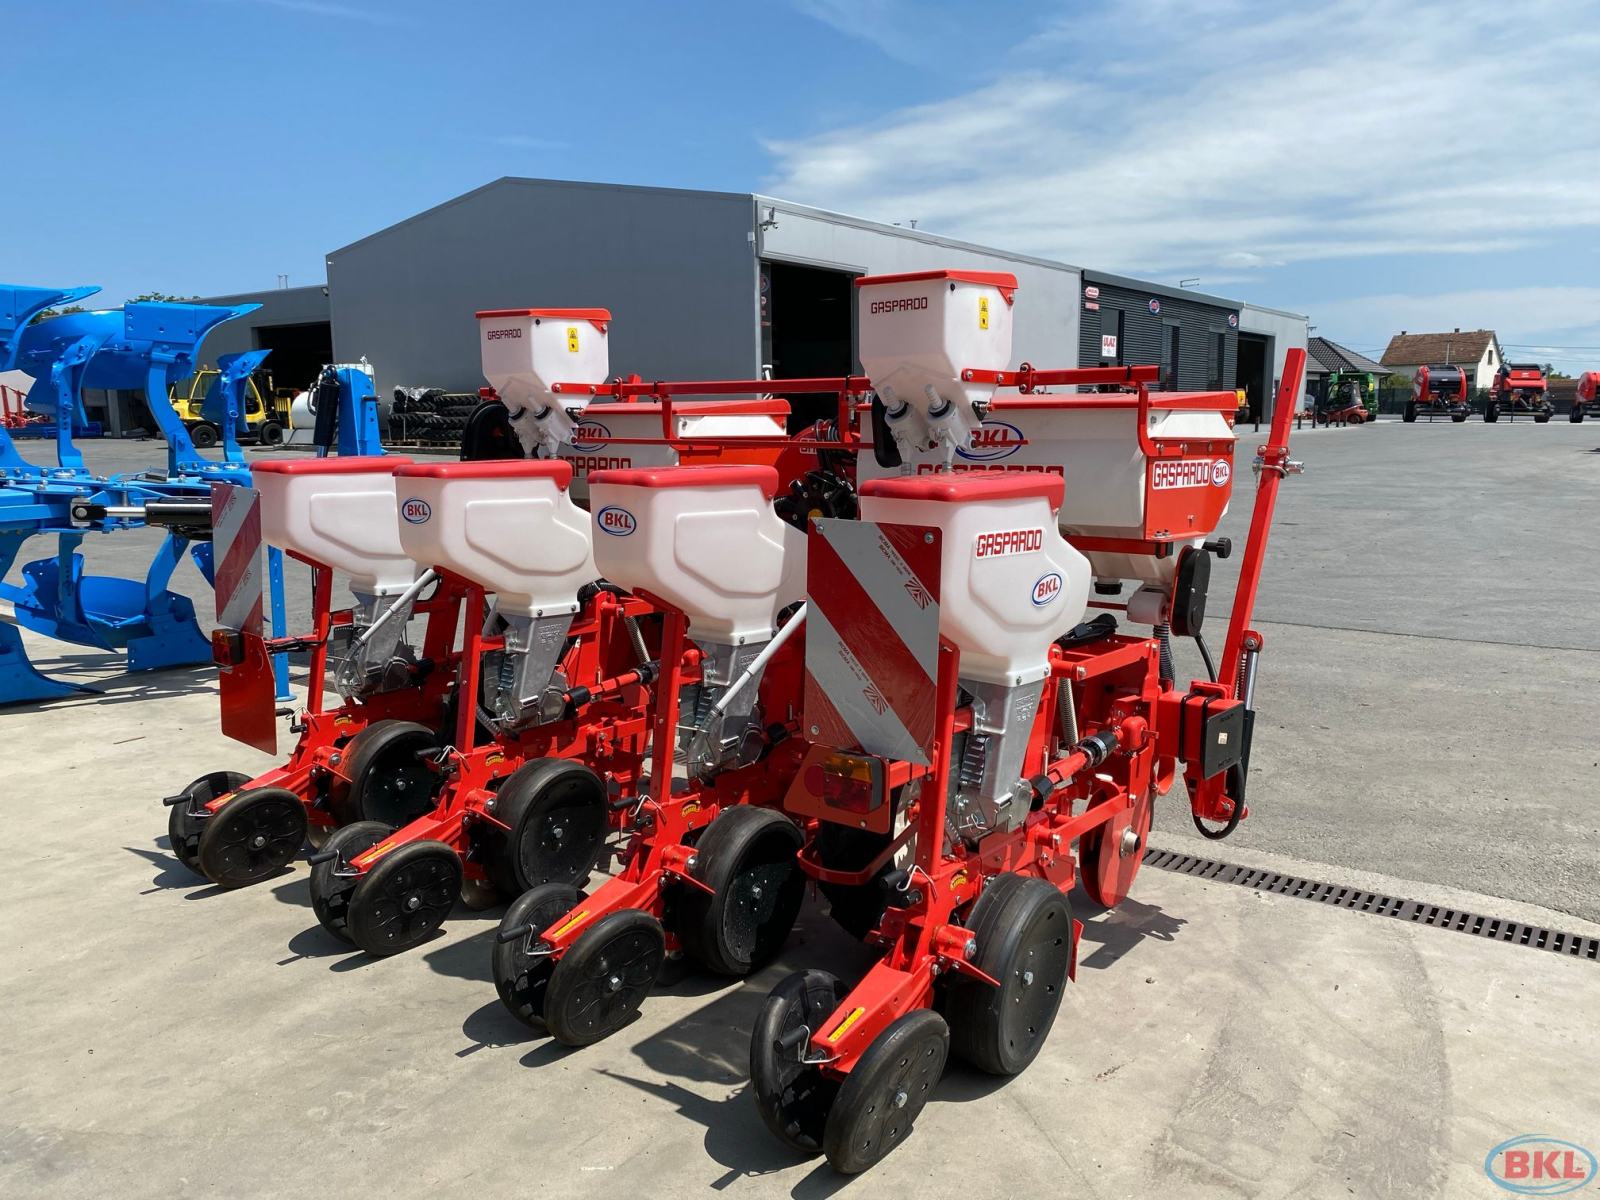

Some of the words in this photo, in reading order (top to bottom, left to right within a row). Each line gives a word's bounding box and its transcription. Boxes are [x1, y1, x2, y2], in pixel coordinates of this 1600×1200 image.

[871, 297, 928, 314] GASPARDO
[487, 328, 522, 341] GASPARDO
[1153, 462, 1209, 487] GASPARDO
[1215, 466, 1228, 478] BKL
[407, 504, 428, 516] BKL
[604, 512, 632, 528] BKL
[976, 529, 1042, 557] GASPARDO
[1037, 577, 1058, 598] BKL
